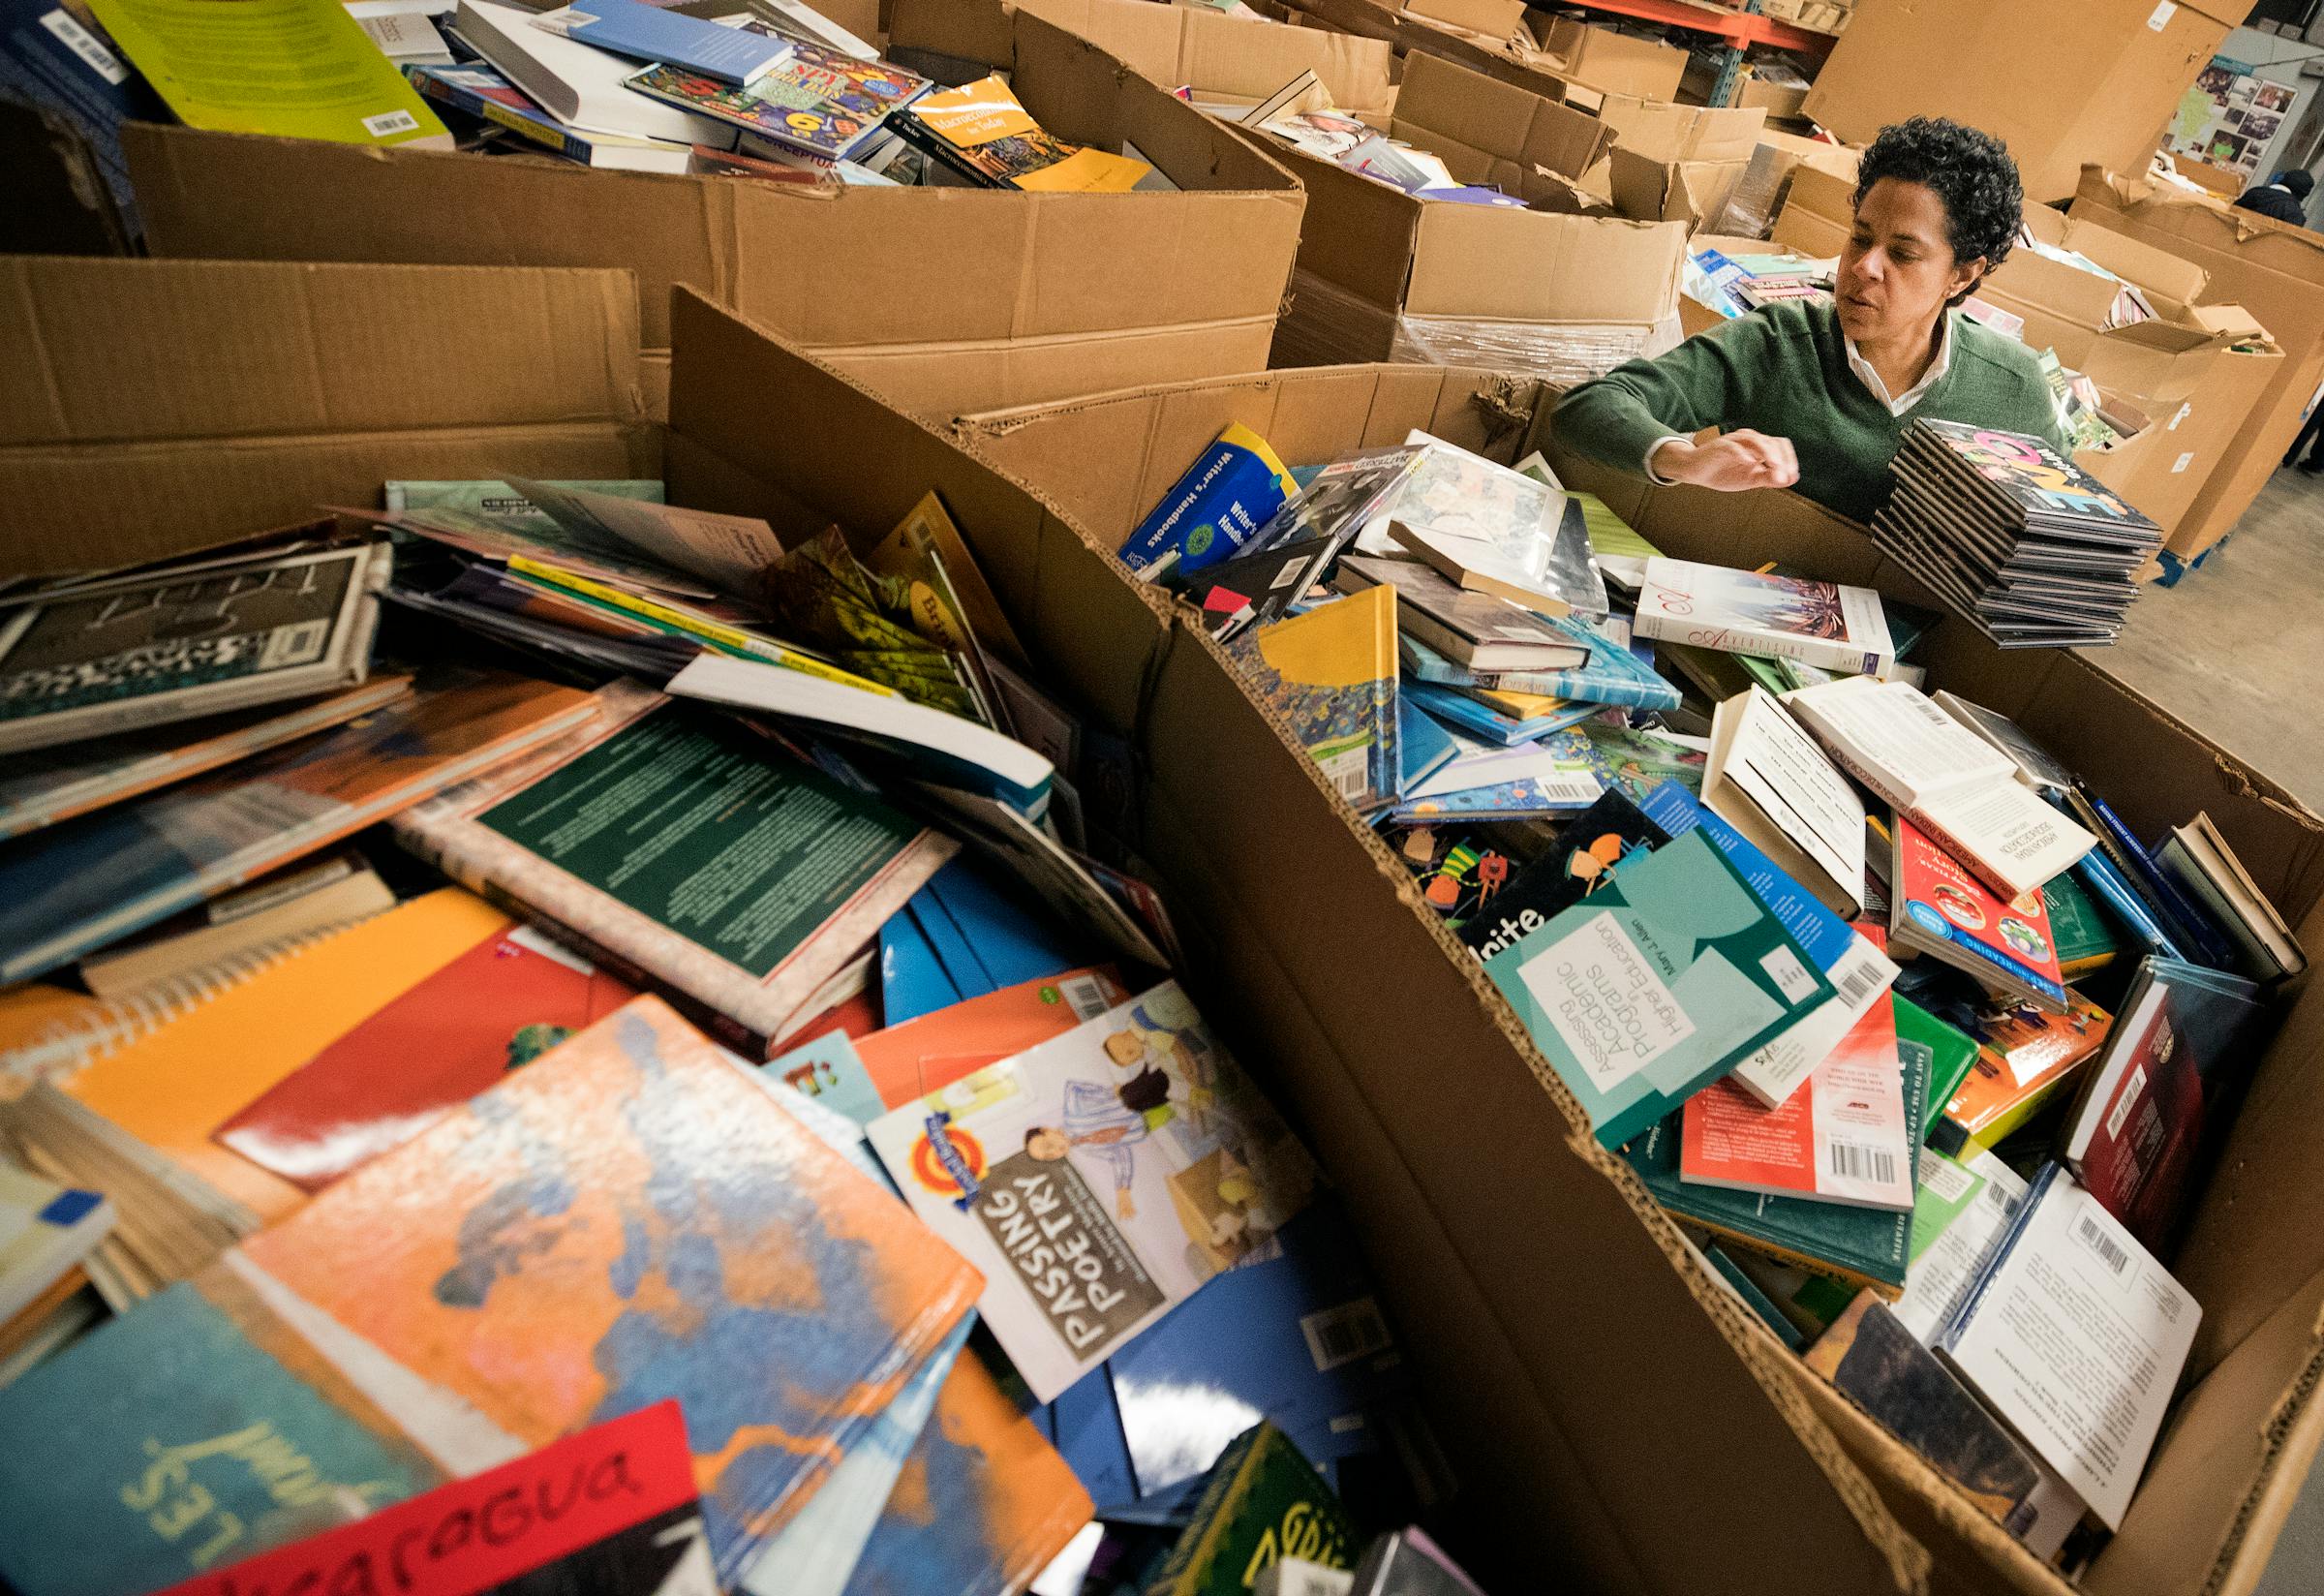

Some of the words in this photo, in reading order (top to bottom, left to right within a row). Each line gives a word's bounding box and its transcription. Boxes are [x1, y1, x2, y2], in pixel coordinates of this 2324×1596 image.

[1195, 451, 1234, 493] Writer's
[1147, 492, 1198, 548] Handbooks
[1230, 500, 1258, 536] Writer's
[1931, 856, 1970, 884] Story
[1595, 920, 1649, 990] Education
[1631, 918, 1649, 943] Allen
[1966, 937, 2014, 971] READING
[1657, 951, 1677, 976] Mary
[1556, 961, 1631, 1056] Academic
[1585, 963, 1657, 1059] Programs
[1644, 987, 1683, 1037] Higher
[1558, 998, 1616, 1074] Assessing
[983, 1188, 1107, 1349] PASSING
[1012, 1172, 1127, 1313] POETRY
